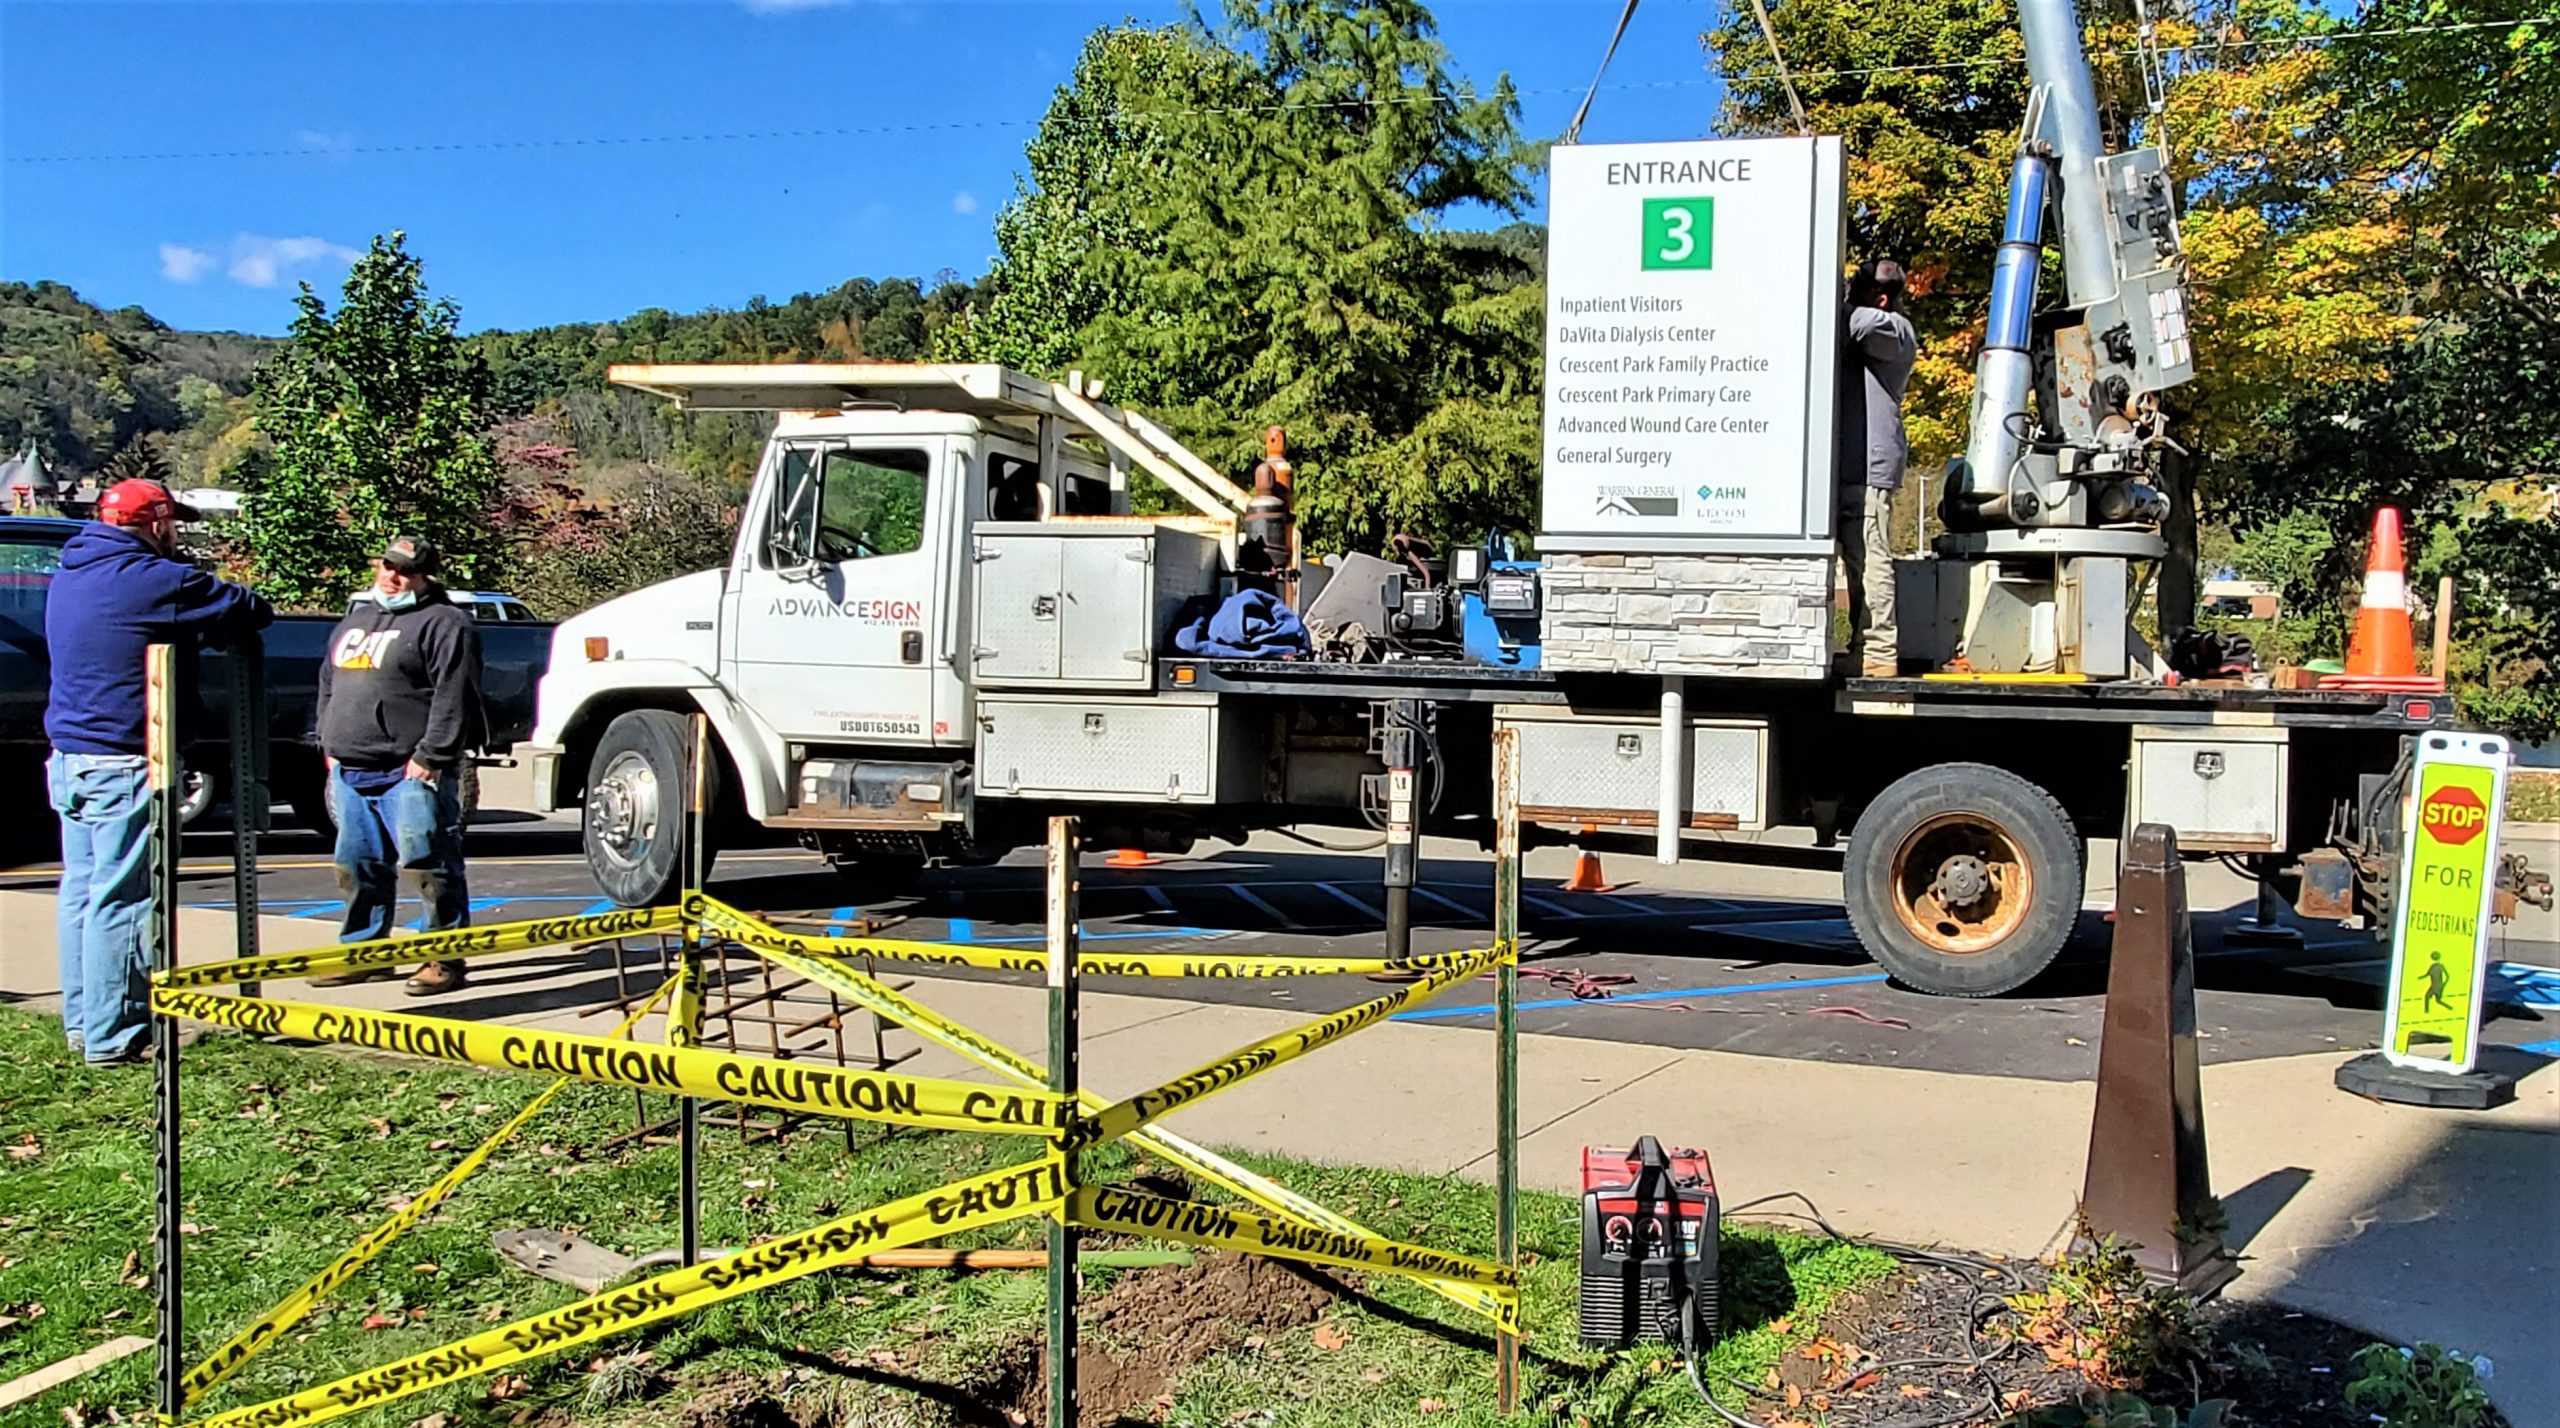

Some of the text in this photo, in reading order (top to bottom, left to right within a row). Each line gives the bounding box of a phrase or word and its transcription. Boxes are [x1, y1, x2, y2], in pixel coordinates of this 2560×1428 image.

[1607, 158, 1752, 185] ENTRANCE
[1659, 206, 1695, 262] 3
[1560, 296, 1683, 317] Inpatient Visitors
[1559, 325, 1716, 346] DaVita Dialysis Center
[1559, 355, 1769, 376] Crescent Park Family Practice
[1558, 386, 1752, 406] Crescent Park Primary Care
[1558, 416, 1769, 434] Advanced Wound Care Center
[1557, 447, 1672, 468] General Surgery
[1714, 487, 1746, 500] AHN
[331, 627, 401, 670] CAT
[840, 720, 920, 735] USDOT650543
[2425, 803, 2484, 828] STOP
[2424, 864, 2472, 889] FOR
[2410, 910, 2474, 937] PEDESTRIANS
[313, 1011, 472, 1062] CAUTION
[502, 1036, 683, 1089] CAUTION
[716, 1061, 922, 1117] CAUTION
[1094, 1189, 1238, 1239] CAUTION
[1257, 1218, 1373, 1262] CAUTION
[327, 1344, 484, 1407] CAUTION
[503, 1279, 676, 1353] CAUTION
[700, 1214, 890, 1290] CAUTION
